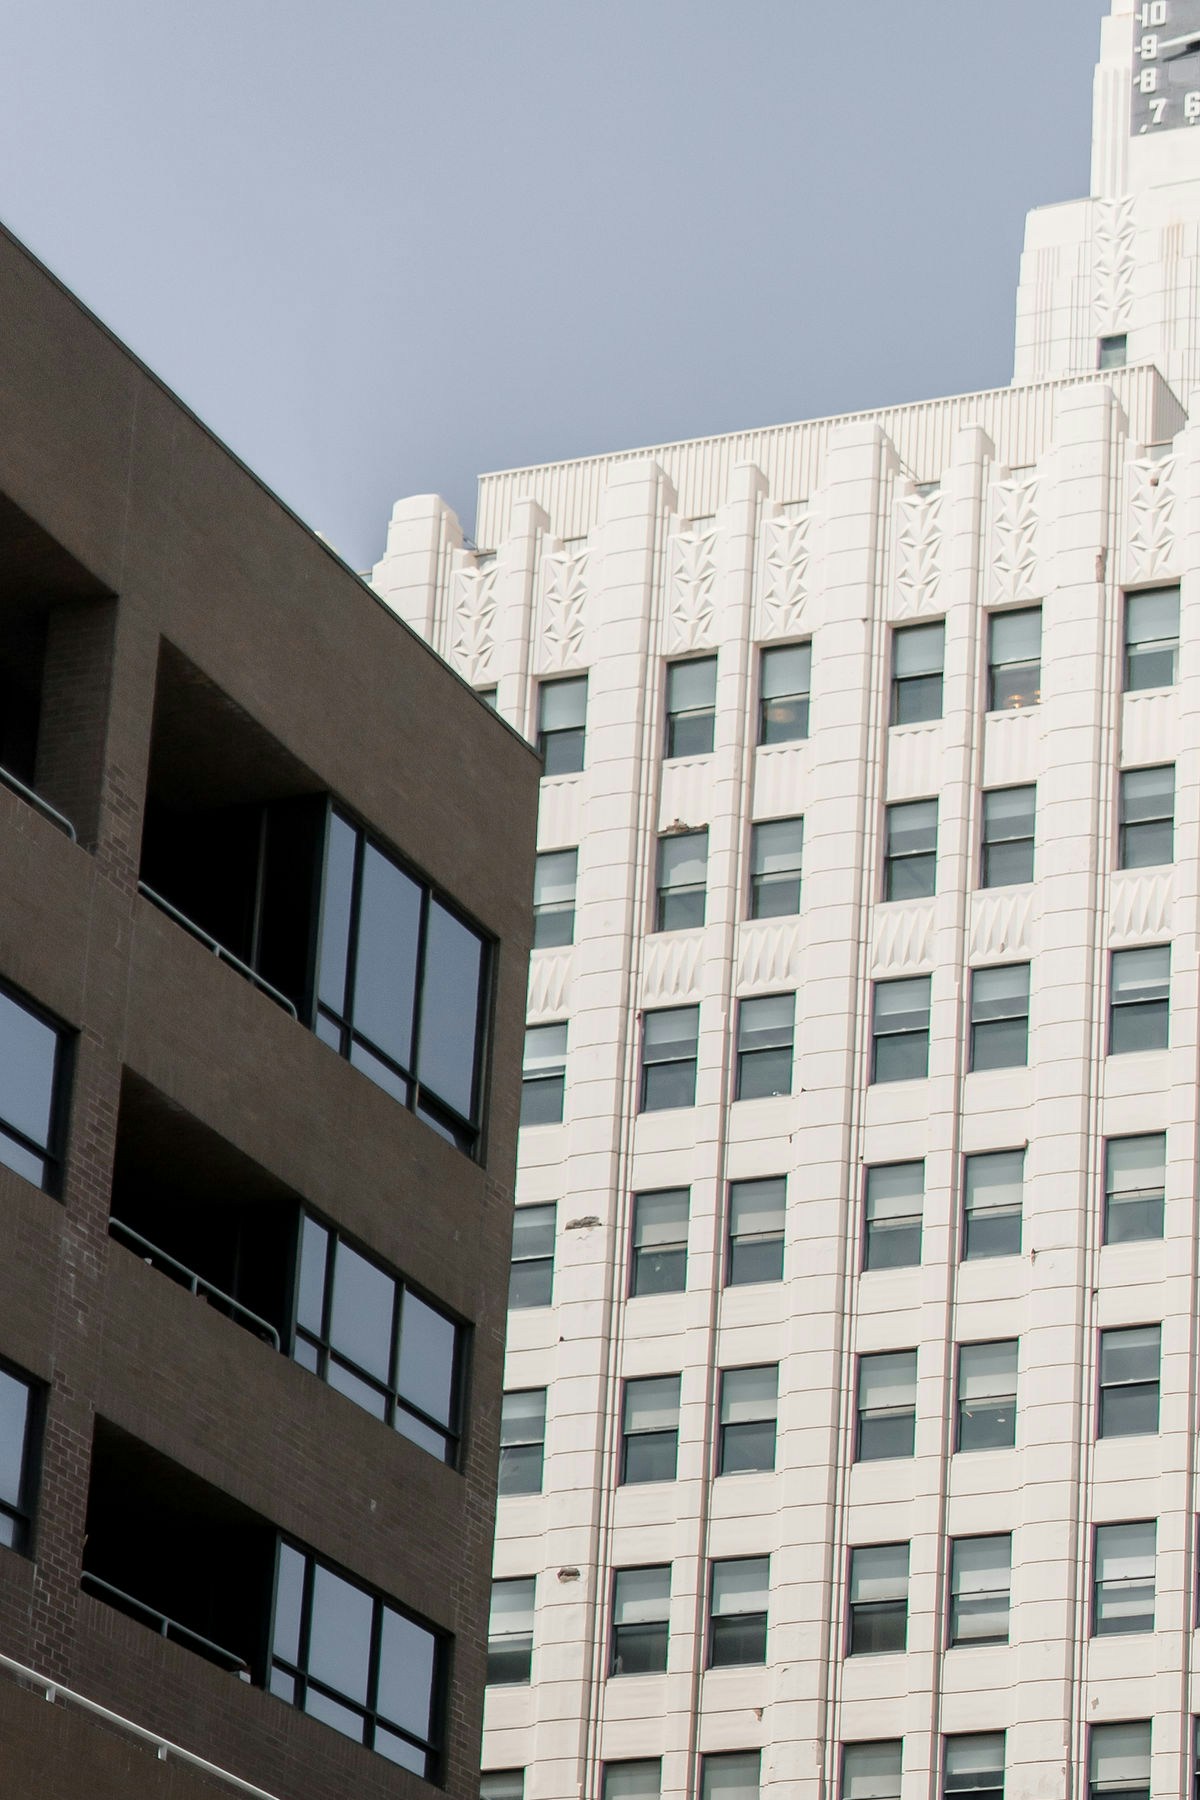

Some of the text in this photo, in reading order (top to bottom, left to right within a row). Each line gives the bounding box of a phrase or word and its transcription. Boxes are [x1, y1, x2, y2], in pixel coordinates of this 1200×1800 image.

[1141, 1, 1167, 28] 10
[1140, 34, 1158, 60] 9
[1139, 67, 1158, 93] 8
[1149, 98, 1168, 124] 7
